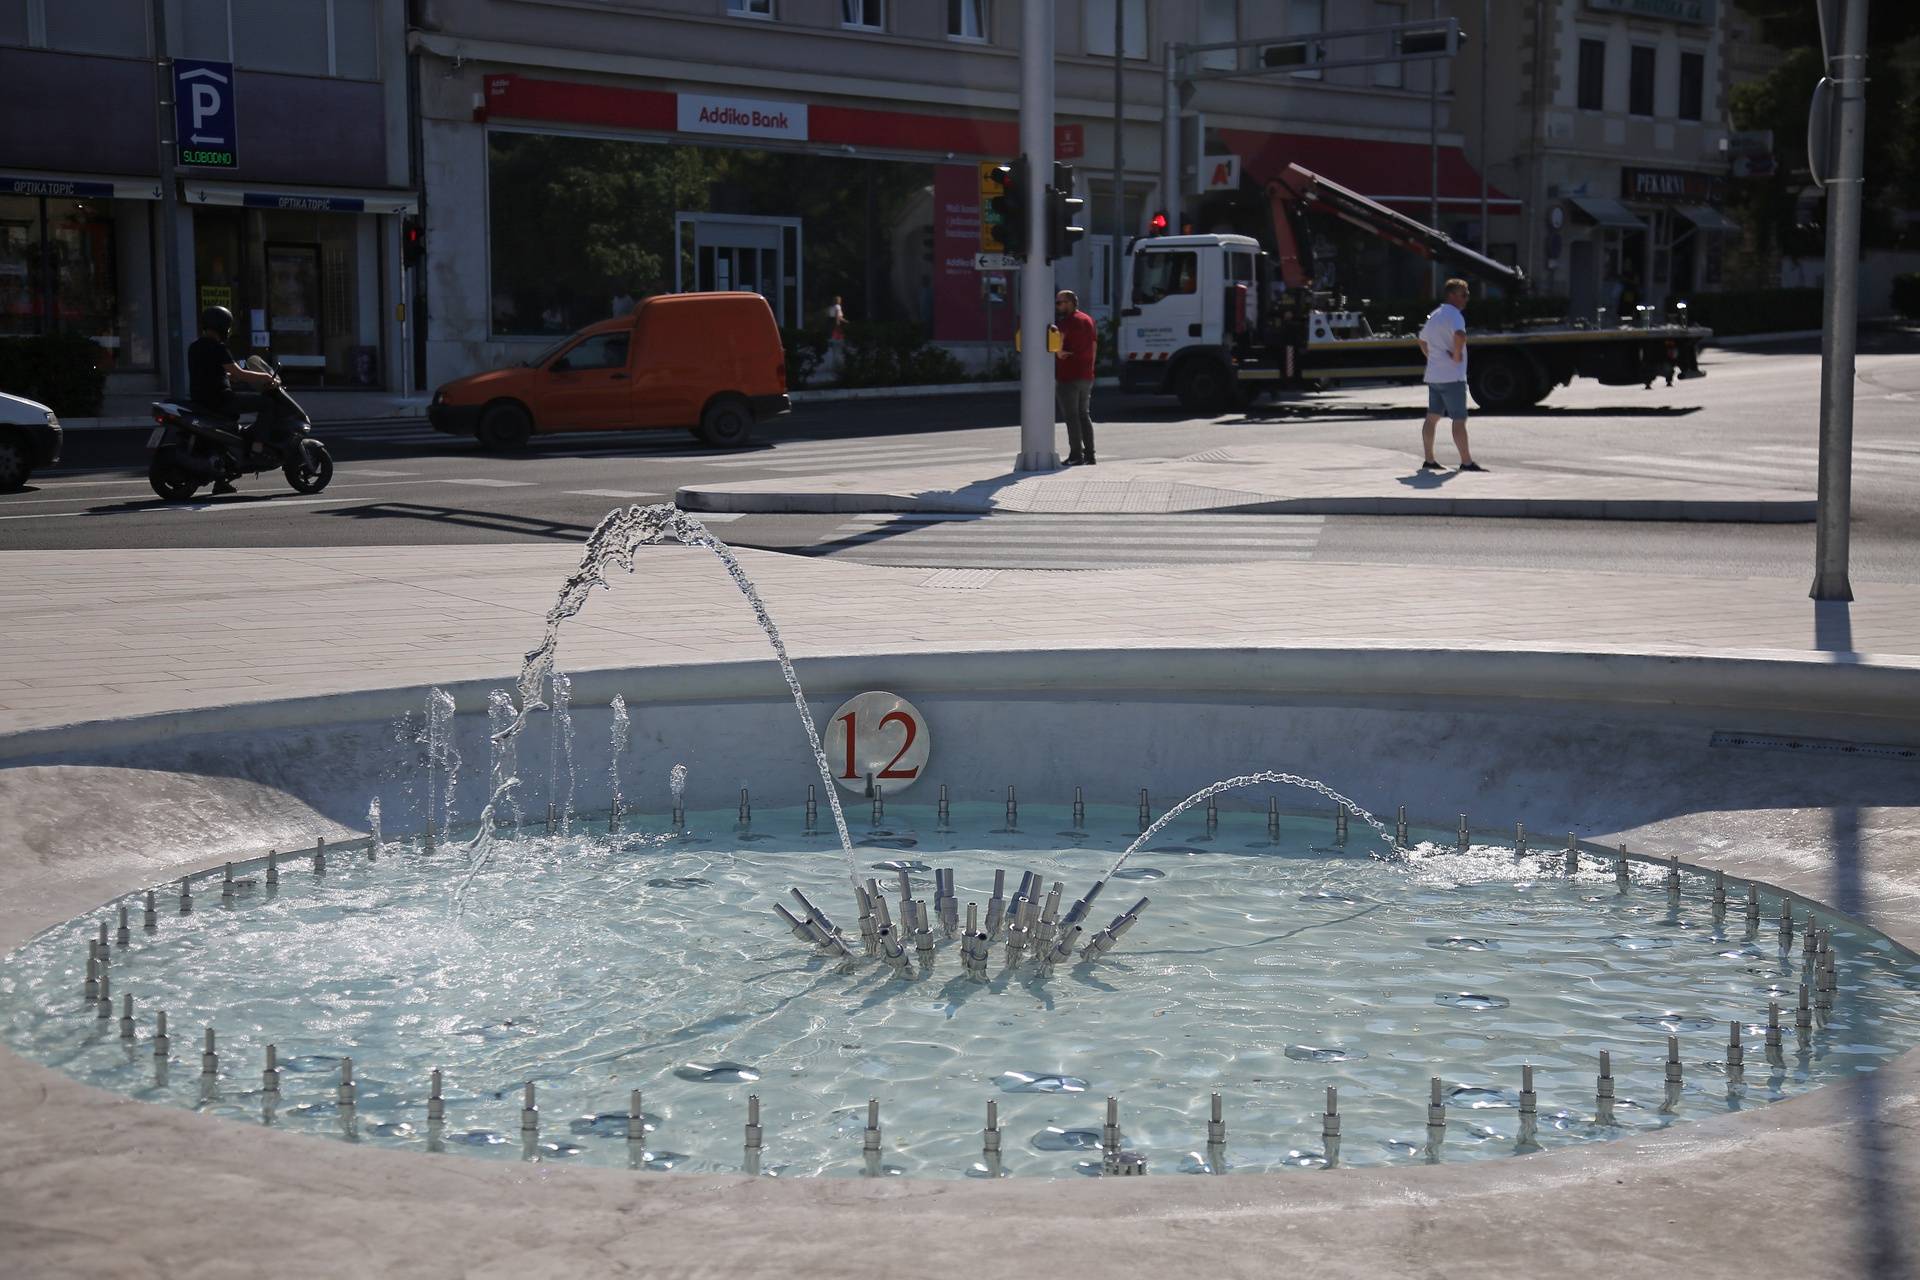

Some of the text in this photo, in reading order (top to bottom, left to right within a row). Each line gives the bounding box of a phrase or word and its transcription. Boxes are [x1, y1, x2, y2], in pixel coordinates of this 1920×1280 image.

[191, 83, 221, 129] P
[698, 106, 789, 129] Addiko Bank
[183, 150, 232, 165] SLOBODNO
[1211, 160, 1232, 186] A1
[14, 180, 75, 195] OPTIKA TOPIĆ
[278, 196, 331, 210] OPTIKA TOPIĆ
[837, 711, 920, 779] 12
